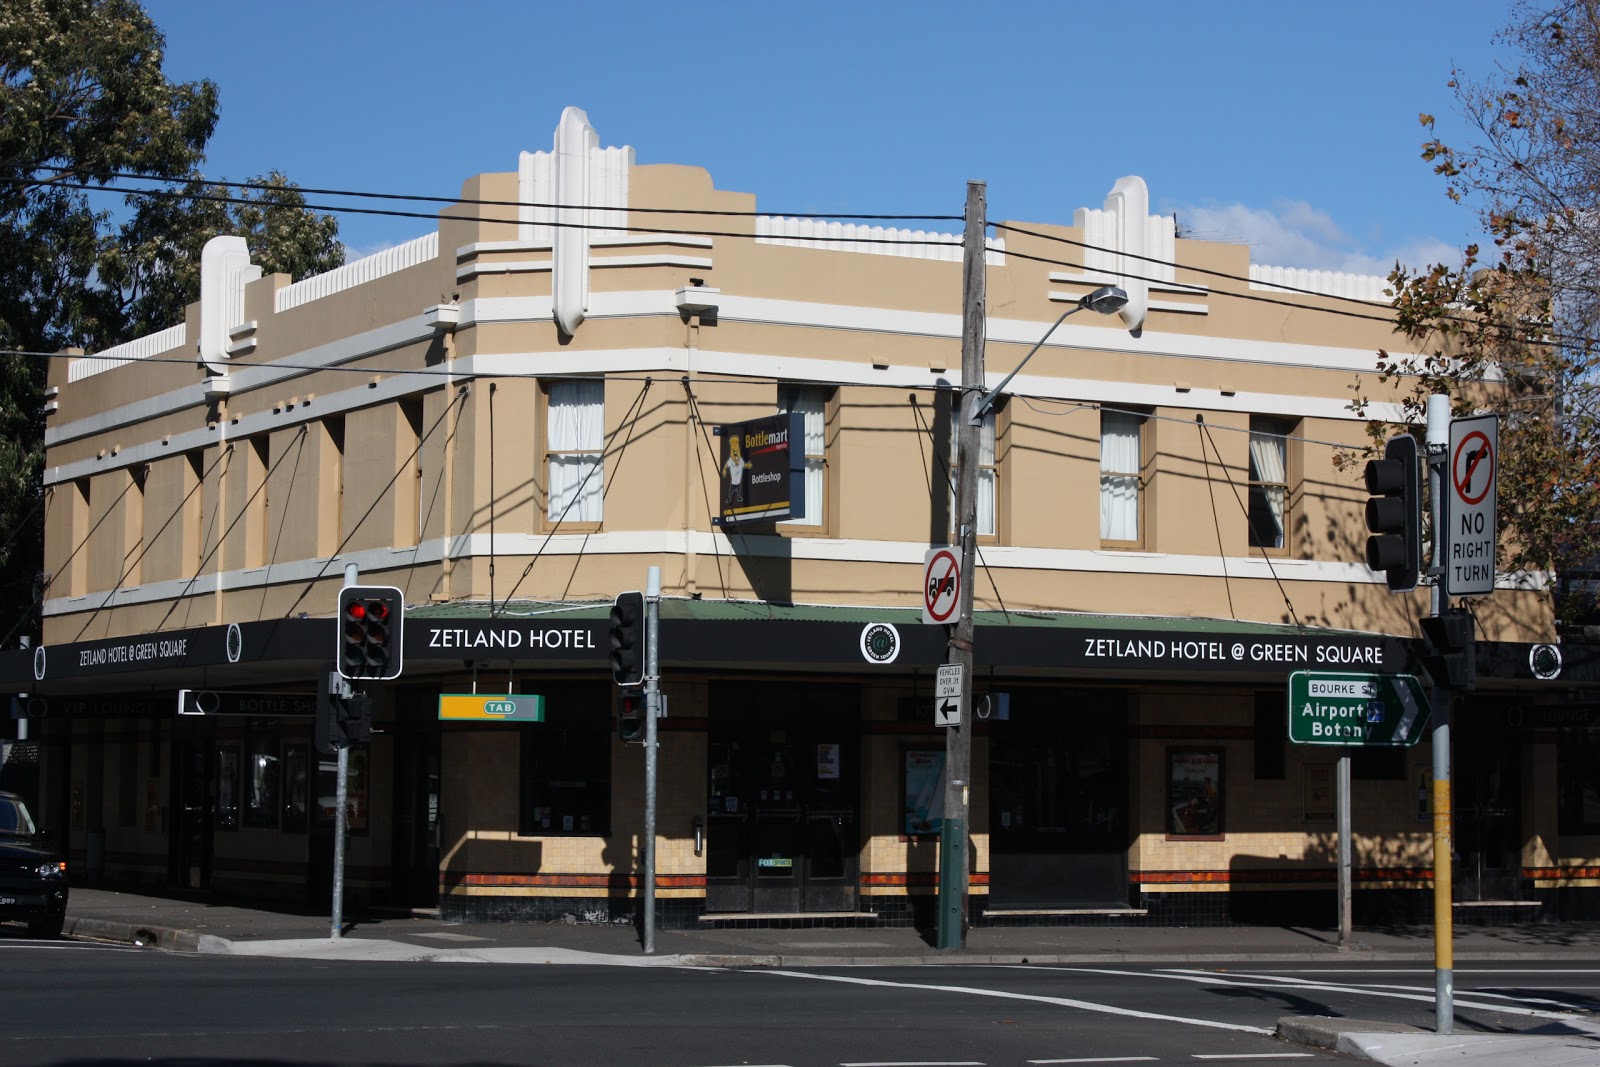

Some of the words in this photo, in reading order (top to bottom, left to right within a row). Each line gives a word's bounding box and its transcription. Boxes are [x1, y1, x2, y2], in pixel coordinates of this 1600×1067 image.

[745, 428, 788, 449] Bottlemart
[751, 471, 781, 485] Bottleshop
[1461, 512, 1485, 535] NO
[1453, 541, 1490, 559] RIGHT
[1455, 564, 1489, 582] TURN
[428, 629, 522, 648] ZETLAND
[529, 629, 596, 648] HOTEL
[79, 648, 107, 666] ZETLAND
[108, 645, 128, 663] HOTEL
[128, 644, 135, 661] @
[135, 642, 158, 660] GREEN
[159, 639, 188, 658] SQUARE
[1084, 638, 1166, 658] ZETLAND
[1171, 641, 1226, 660] HOTEL
[1231, 643, 1245, 660] @
[1250, 643, 1308, 662] GREEN
[1316, 645, 1383, 664] SQUARE
[939, 667, 961, 676] VEHICLES
[939, 677, 952, 685] OVER
[943, 686, 955, 695] GVM
[1311, 684, 1355, 694] BOURKE
[1361, 685, 1374, 694] ST
[94, 702, 153, 713] LOUNGE
[239, 699, 287, 712] BOTTLE
[294, 700, 317, 712] SHO
[489, 703, 512, 712] TAB
[1301, 702, 1364, 720] Airport
[1543, 708, 1591, 720] LOUNGE
[1312, 722, 1373, 741] Botany
[758, 858, 773, 867] FOX
